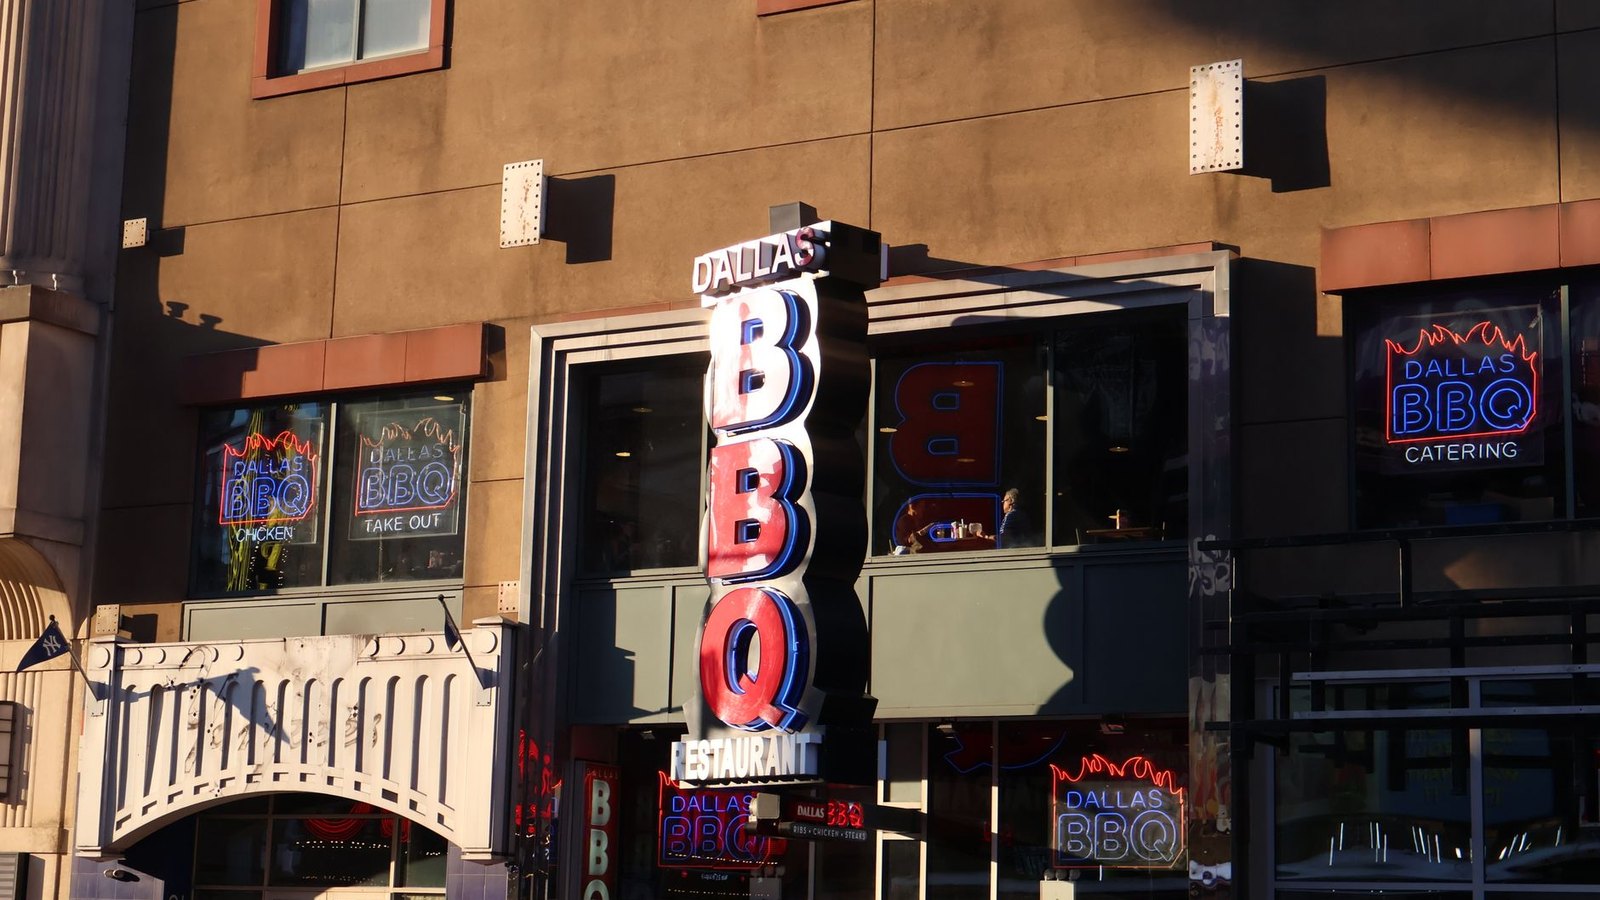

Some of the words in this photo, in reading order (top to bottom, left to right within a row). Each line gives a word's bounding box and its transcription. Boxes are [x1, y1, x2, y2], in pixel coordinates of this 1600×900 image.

[692, 227, 815, 294] DALLAS
[1405, 353, 1516, 380] DALLAS
[1393, 378, 1533, 434] BBQ
[370, 443, 444, 464] DALLAS
[1405, 441, 1518, 463] CATERING
[234, 456, 303, 476] DALLAS
[224, 474, 310, 518] BBQ
[360, 461, 451, 509] BBQ
[365, 516, 402, 533] TAKE
[409, 512, 442, 530] OUT
[701, 288, 810, 733] BBQ
[236, 526, 294, 543] CHICKEN
[670, 733, 820, 781] RESTAURANT
[1066, 789, 1163, 809] DALLAS
[797, 805, 825, 818] DALLAS
[793, 825, 807, 835] RIBS
[812, 827, 839, 838] CHICKEN
[1057, 809, 1177, 862] BBQ
